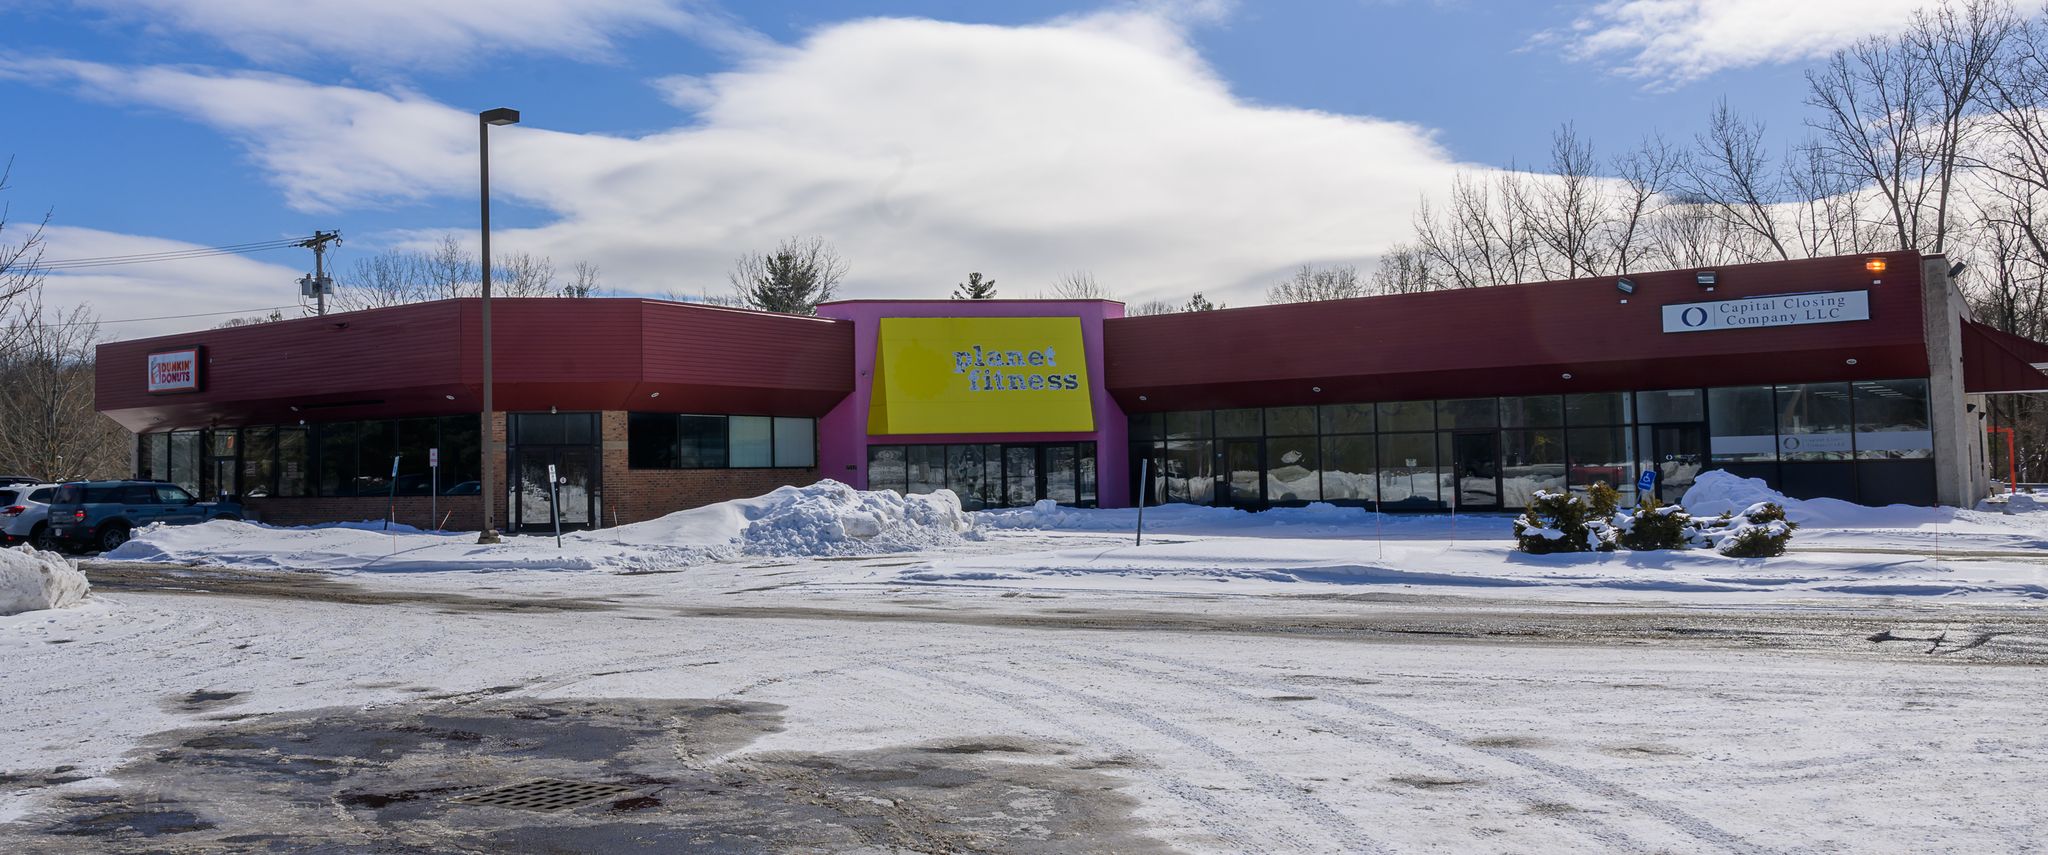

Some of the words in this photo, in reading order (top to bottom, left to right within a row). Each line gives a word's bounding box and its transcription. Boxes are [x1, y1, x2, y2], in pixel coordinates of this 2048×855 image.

[1719, 299, 1775, 315] Capital
[1783, 295, 1846, 309] Closing
[1726, 312, 1797, 326] Company
[1806, 307, 1841, 320] LLC
[952, 345, 1057, 374] planet
[161, 371, 190, 384] DONUTS
[968, 369, 1079, 392] fitness
